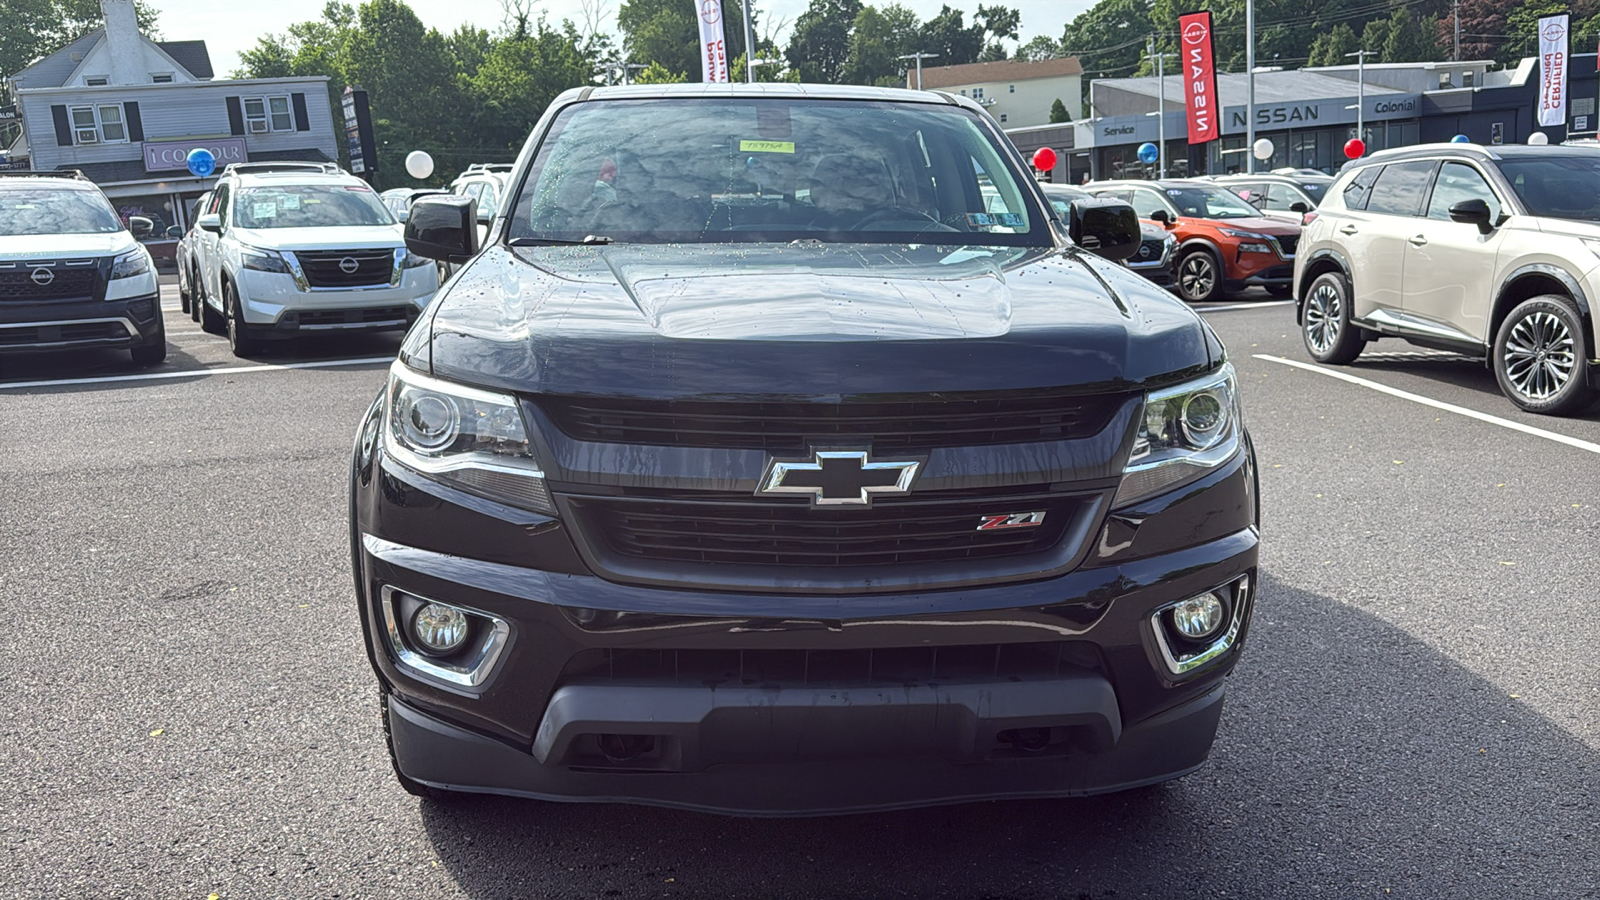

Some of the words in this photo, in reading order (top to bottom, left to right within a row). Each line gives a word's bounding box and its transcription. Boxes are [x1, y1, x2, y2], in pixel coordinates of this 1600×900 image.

[1375, 99, 1416, 113] Colonial
[1232, 105, 1318, 127] NSSAN
[1103, 125, 1135, 136] Service
[161, 146, 239, 163] COOUR
[976, 511, 1047, 530] Z71
